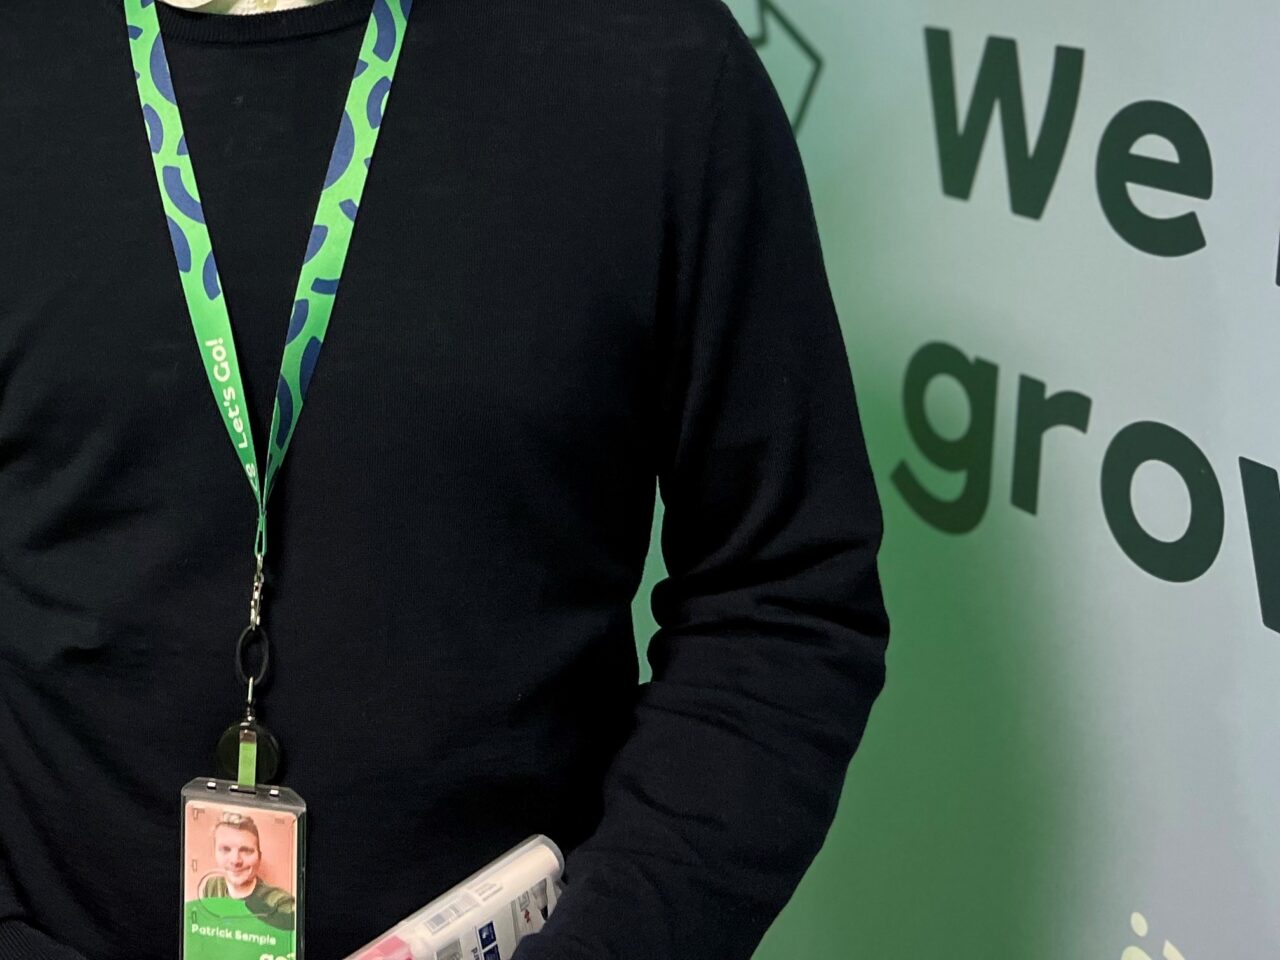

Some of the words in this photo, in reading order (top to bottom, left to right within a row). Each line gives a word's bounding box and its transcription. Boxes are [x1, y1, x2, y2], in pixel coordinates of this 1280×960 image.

[924, 26, 1213, 258] We
[205, 337, 231, 382] Go!
[223, 386, 248, 449] Let's
[191, 923, 232, 939] Patrick
